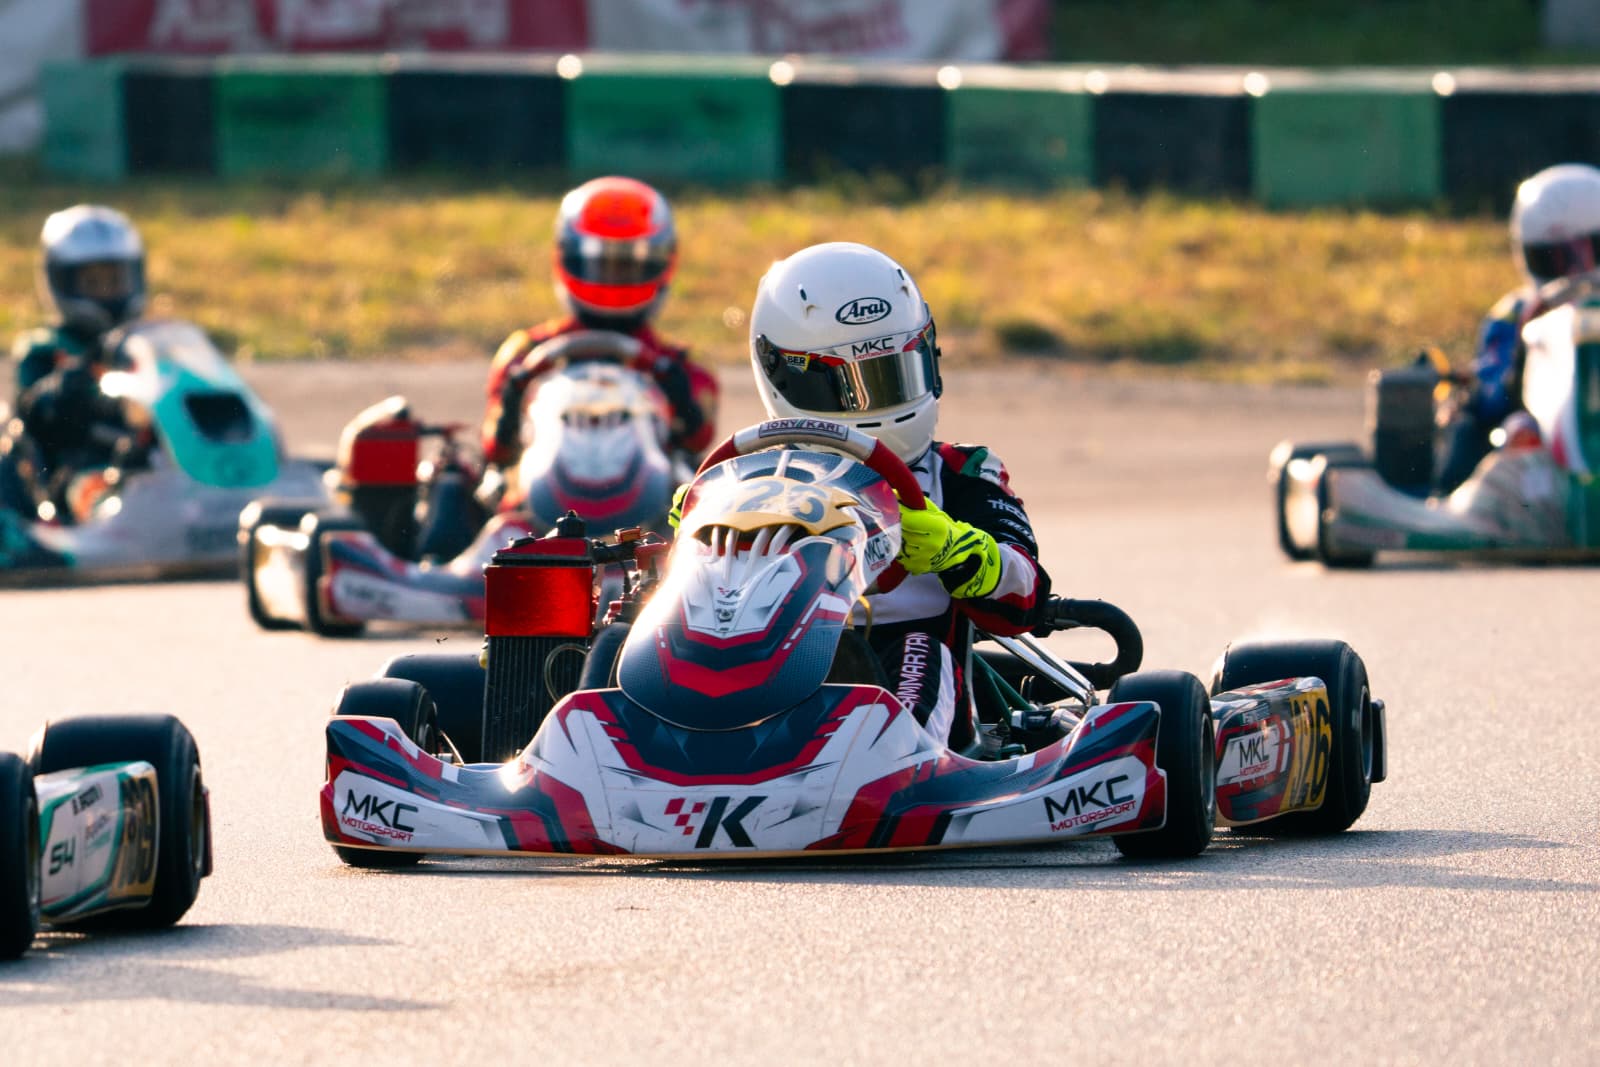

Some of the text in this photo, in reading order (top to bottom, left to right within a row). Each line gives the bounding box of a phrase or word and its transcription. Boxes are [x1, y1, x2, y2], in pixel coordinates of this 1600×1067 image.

[840, 301, 885, 320] Arai
[851, 337, 895, 356] MKC
[342, 788, 419, 832] MKC
[1043, 774, 1134, 823] MKC
[341, 815, 414, 842] MOTORSPORT
[1051, 800, 1136, 832] MOTORSPORT
